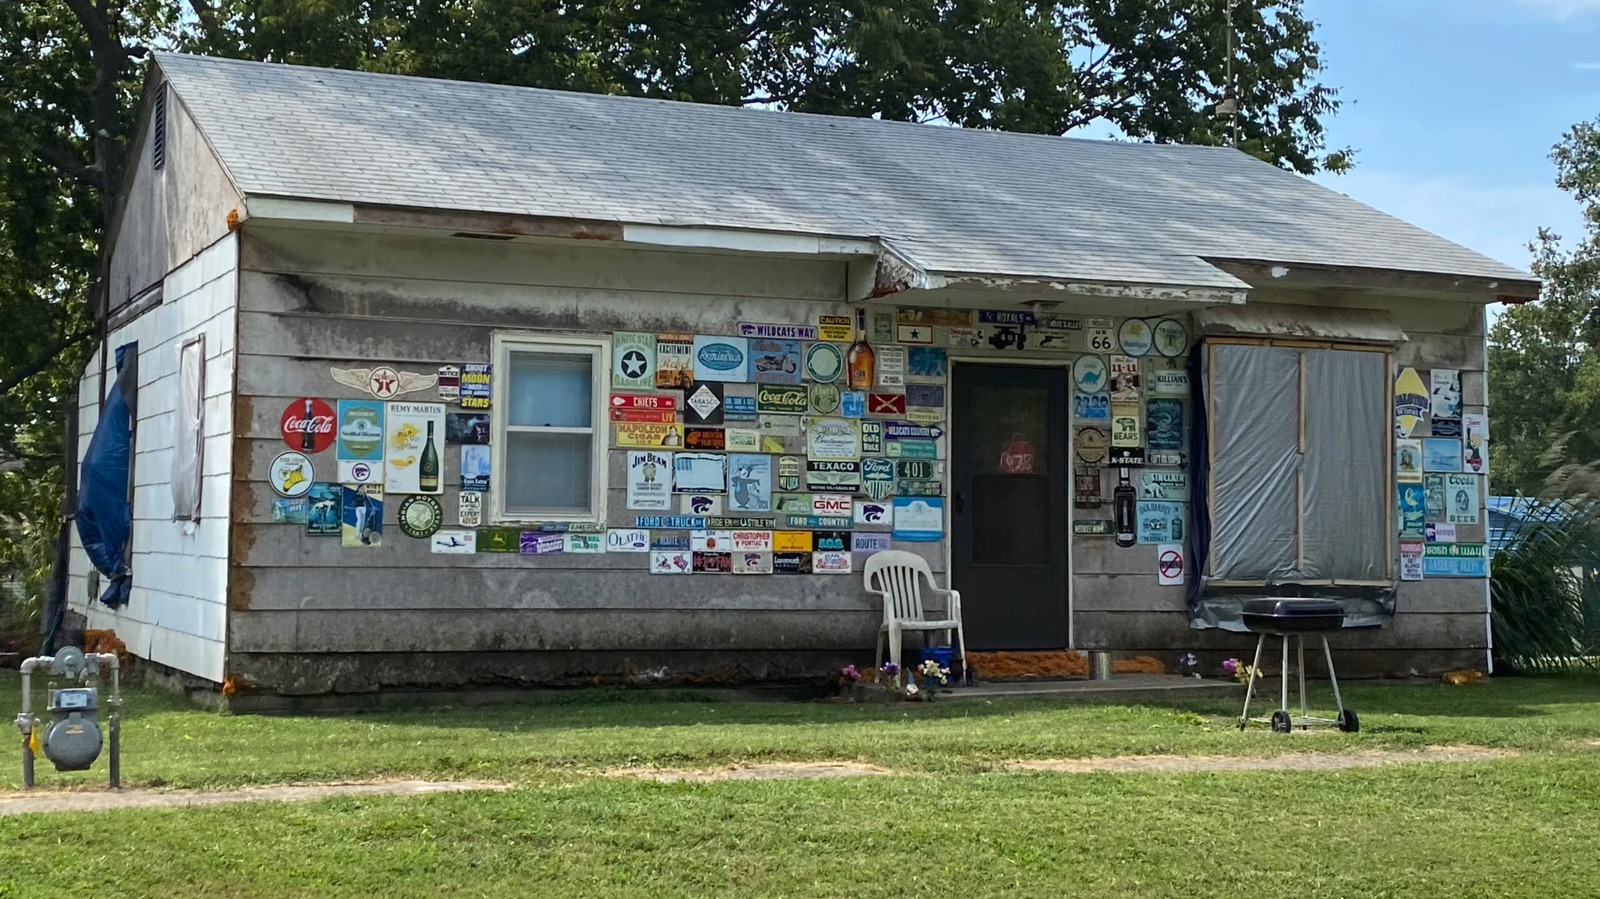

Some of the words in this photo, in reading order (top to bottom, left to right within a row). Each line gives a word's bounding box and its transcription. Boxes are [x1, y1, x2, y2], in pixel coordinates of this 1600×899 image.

[997, 312, 1024, 322] ROYALS
[757, 325, 795, 337] WILDCATS
[798, 328, 814, 338] WAY
[1091, 337, 1111, 350] 66
[462, 374, 490, 384] MOON
[614, 374, 653, 387] GASOLINE
[461, 398, 490, 408] STARS
[633, 396, 658, 408] CHIEFS
[390, 404, 412, 413] REMY
[413, 406, 442, 414] MARTIN
[619, 424, 668, 434] NAPOLEON
[862, 424, 879, 433] OLD
[1113, 432, 1138, 441] BEARS
[863, 442, 879, 451] RULE
[632, 453, 647, 468] JIM
[647, 452, 667, 469] BEAM
[813, 462, 854, 471] TEXACO
[864, 460, 891, 472] Ford
[905, 462, 925, 477] 401
[1151, 473, 1185, 482] SINCLAIR
[460, 495, 480, 503] TALK
[814, 500, 850, 510] GMC
[640, 517, 659, 527] FORD
[670, 517, 696, 527] TRUCK
[711, 517, 724, 526] RIDE
[747, 518, 765, 527] STOLE
[789, 516, 807, 525] FORD
[818, 517, 849, 526] COUNTRY
[1449, 515, 1476, 523] BEER
[608, 531, 648, 547] OLATHE
[660, 535, 678, 545] ROUTE
[732, 532, 770, 540] CHRISTOPHER
[855, 539, 877, 549] ROUTE
[1461, 547, 1481, 558] WAY
